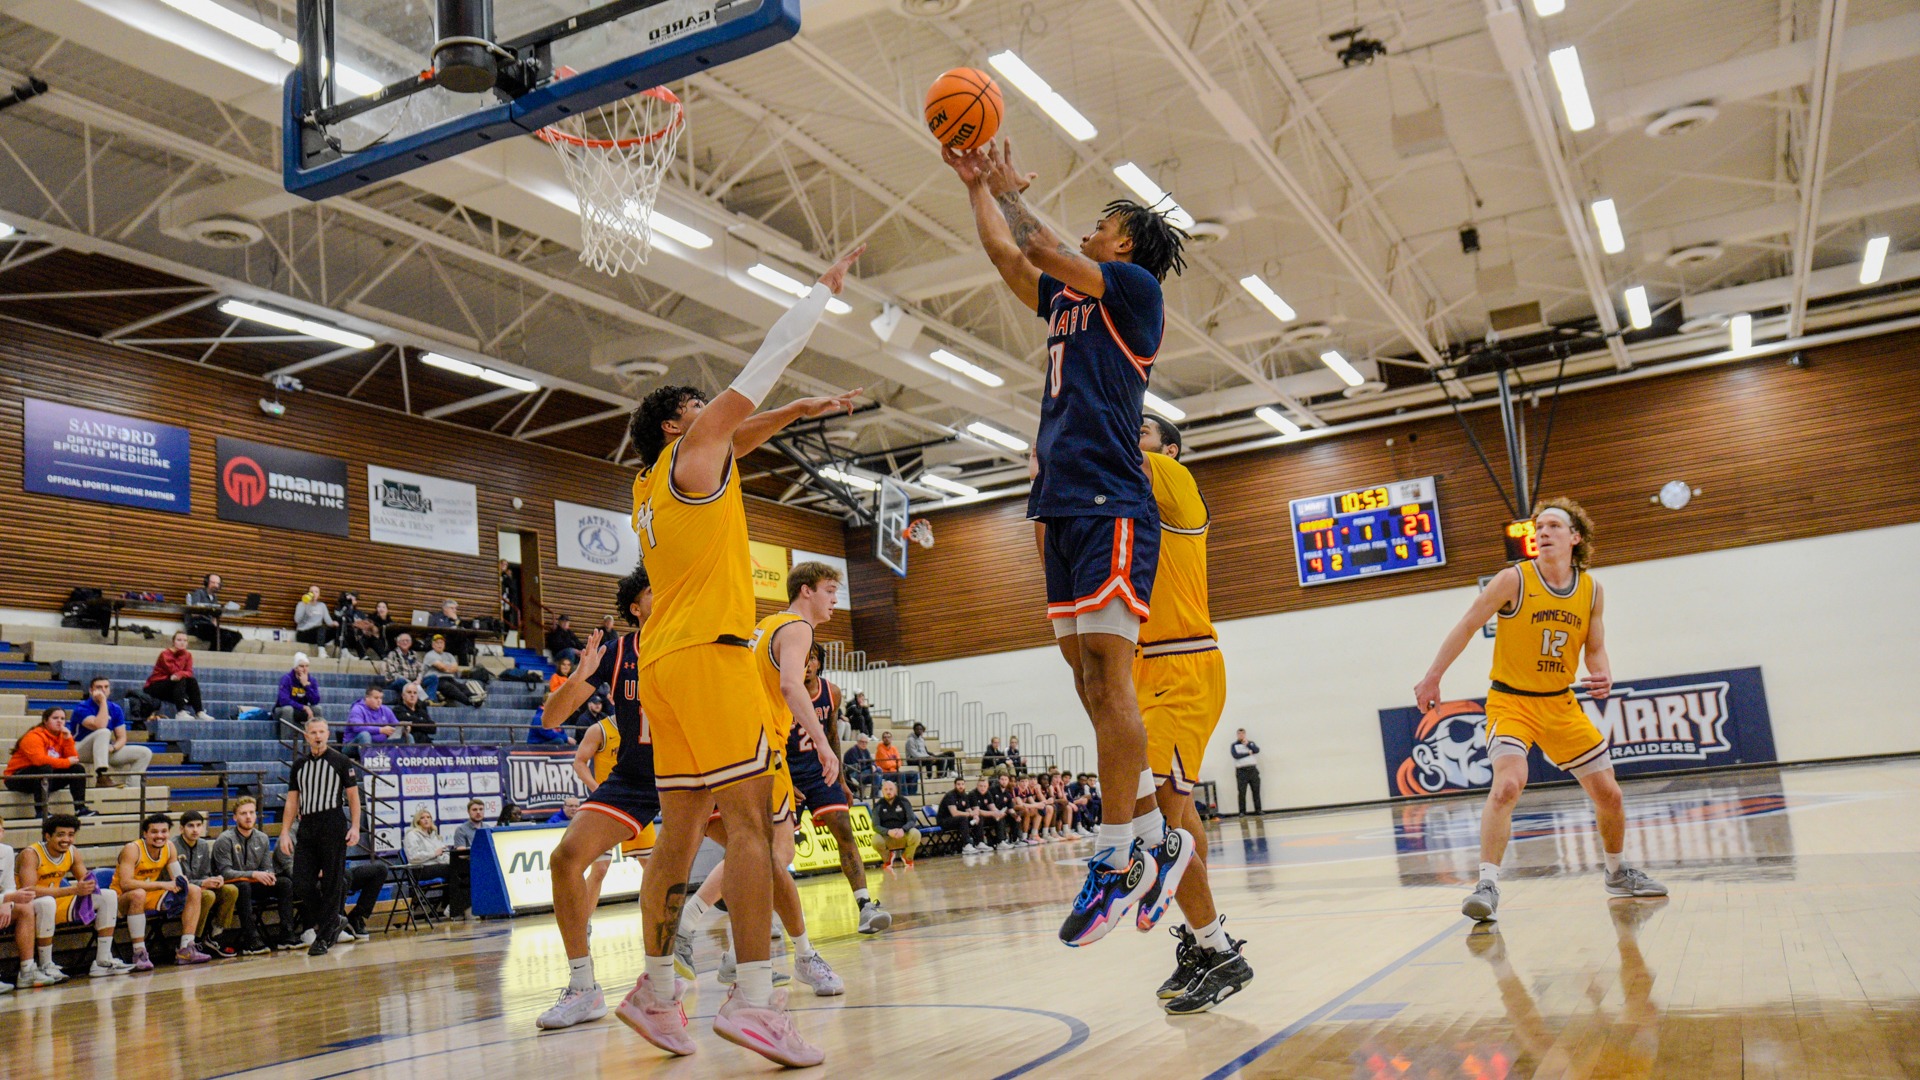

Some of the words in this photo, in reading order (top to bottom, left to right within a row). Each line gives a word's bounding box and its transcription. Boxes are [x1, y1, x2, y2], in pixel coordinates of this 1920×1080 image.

[929, 110, 948, 133] NCA
[1047, 303, 1096, 339] MARY
[1049, 341, 1065, 398] 0
[69, 418, 156, 447] SANFORD
[53, 440, 105, 458] SPORTS
[109, 450, 170, 469] MEDICINE
[67, 434, 158, 458] ORTHOPEDICS
[47, 474, 82, 487] OFFICIAL
[82, 480, 110, 491] SPORTS
[110, 483, 144, 497] MEDICINE
[144, 489, 176, 501] PARTNER
[268, 472, 344, 499] mann
[268, 488, 316, 506] SIGNS,
[320, 496, 344, 510] INC
[374, 483, 433, 512] Dakota
[1341, 487, 1389, 514] 10:53
[1364, 525, 1373, 540] 1
[1404, 513, 1431, 537] 27
[1314, 530, 1334, 549] 11
[1421, 539, 1434, 557] 3
[1395, 544, 1408, 559] 4
[1310, 558, 1324, 572] 4
[1331, 554, 1343, 571] 2
[752, 569, 780, 581] USTED
[1531, 609, 1582, 630] MINNESOTA
[1541, 628, 1569, 658] 12
[1536, 660, 1566, 673] STATE
[1580, 690, 1718, 745] MARY
[396, 756, 454, 767] CORPORATE
[456, 755, 499, 766] PARTNERS
[1609, 742, 1697, 759] RAUDERS
[363, 756, 391, 768] NSIC
[405, 777, 428, 785] MIDCO
[406, 785, 431, 793] SPORTS
[818, 838, 839, 852] WIL
[855, 834, 873, 848] INGS
